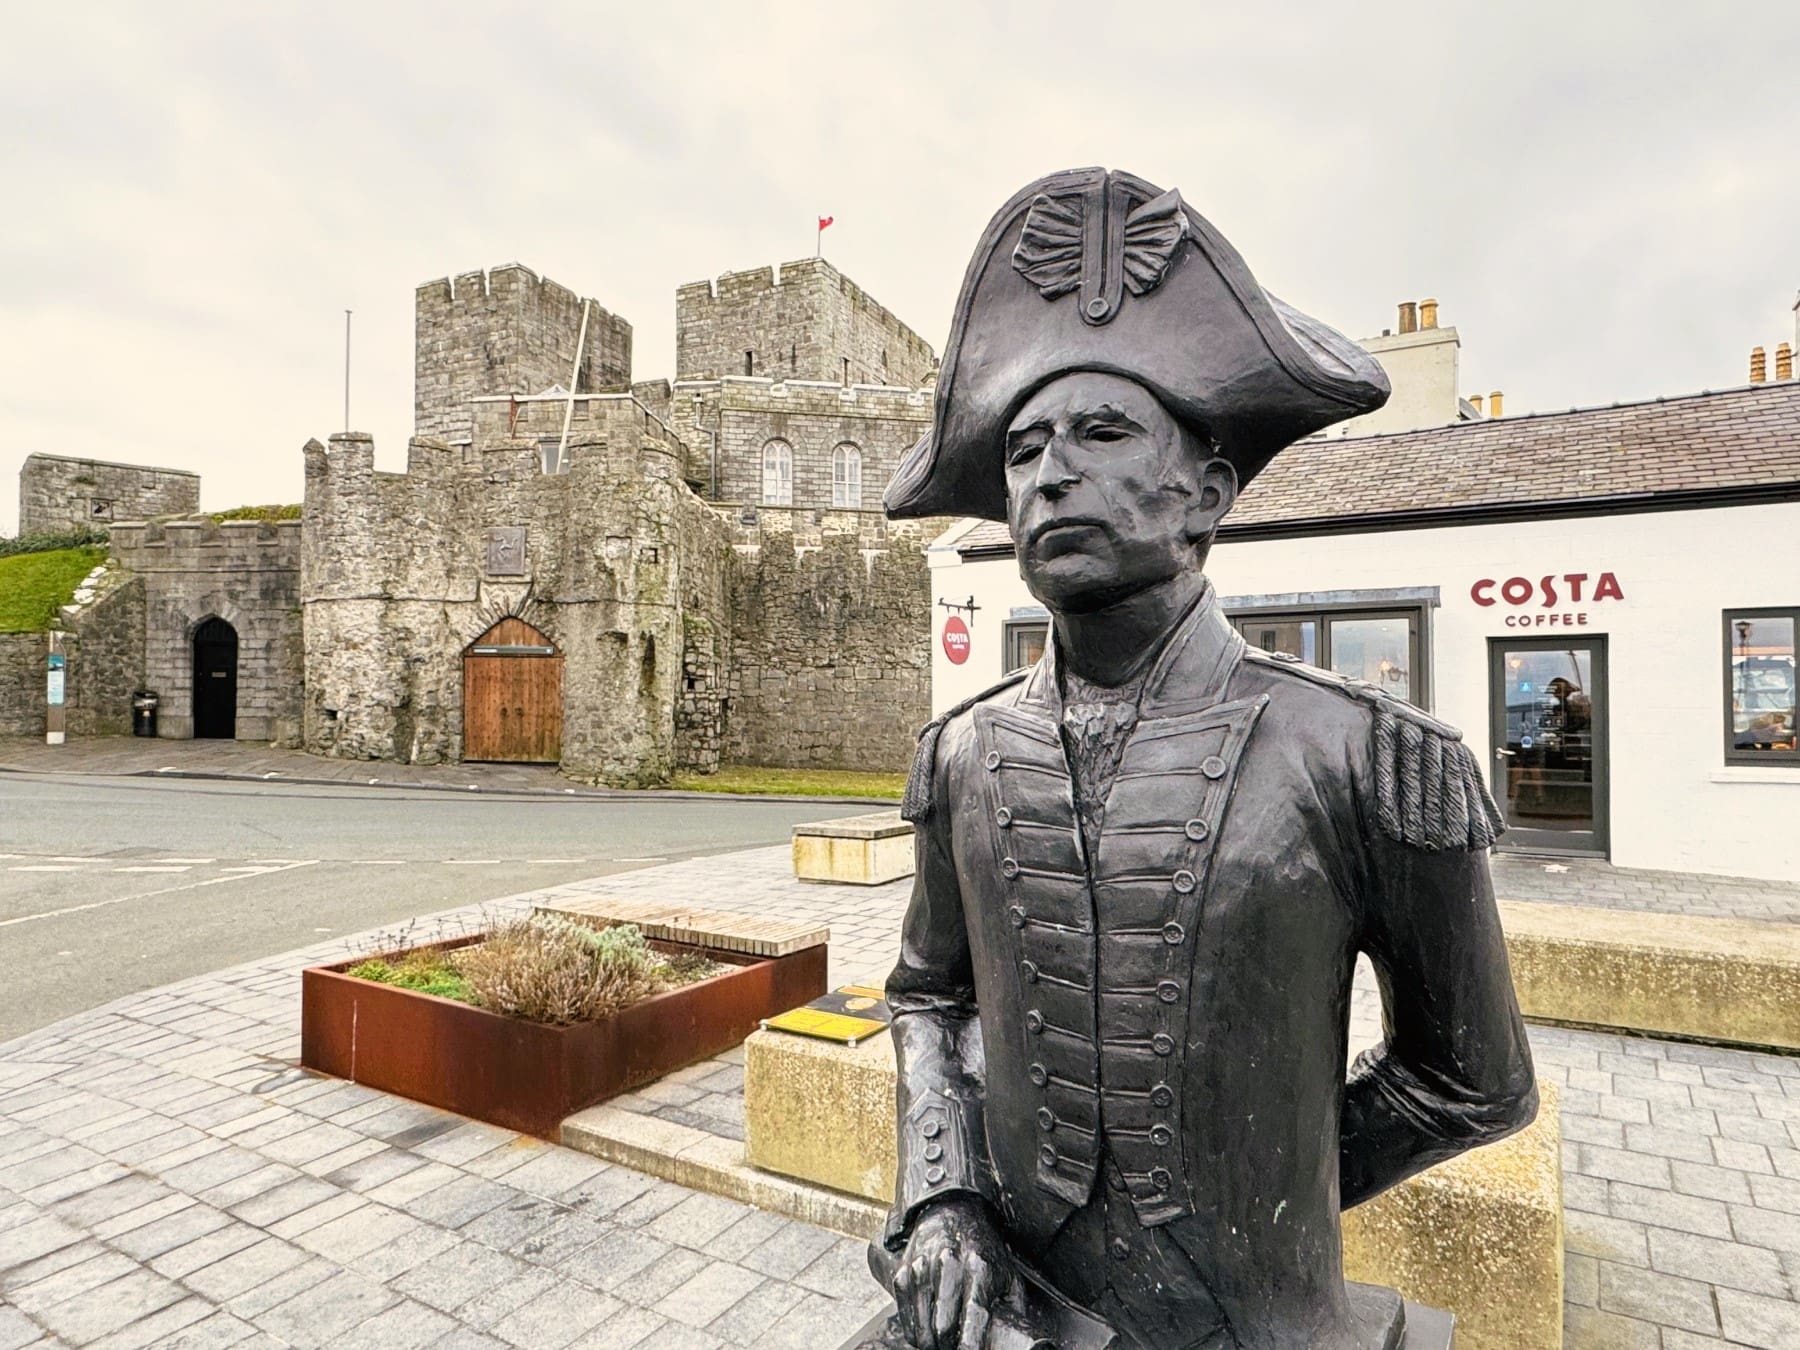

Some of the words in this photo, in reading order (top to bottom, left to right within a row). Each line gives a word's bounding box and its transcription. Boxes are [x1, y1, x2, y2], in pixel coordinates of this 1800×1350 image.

[1470, 572, 1624, 608] COSTA
[1505, 613, 1588, 627] COFFEE
[947, 632, 969, 643] COSTA
